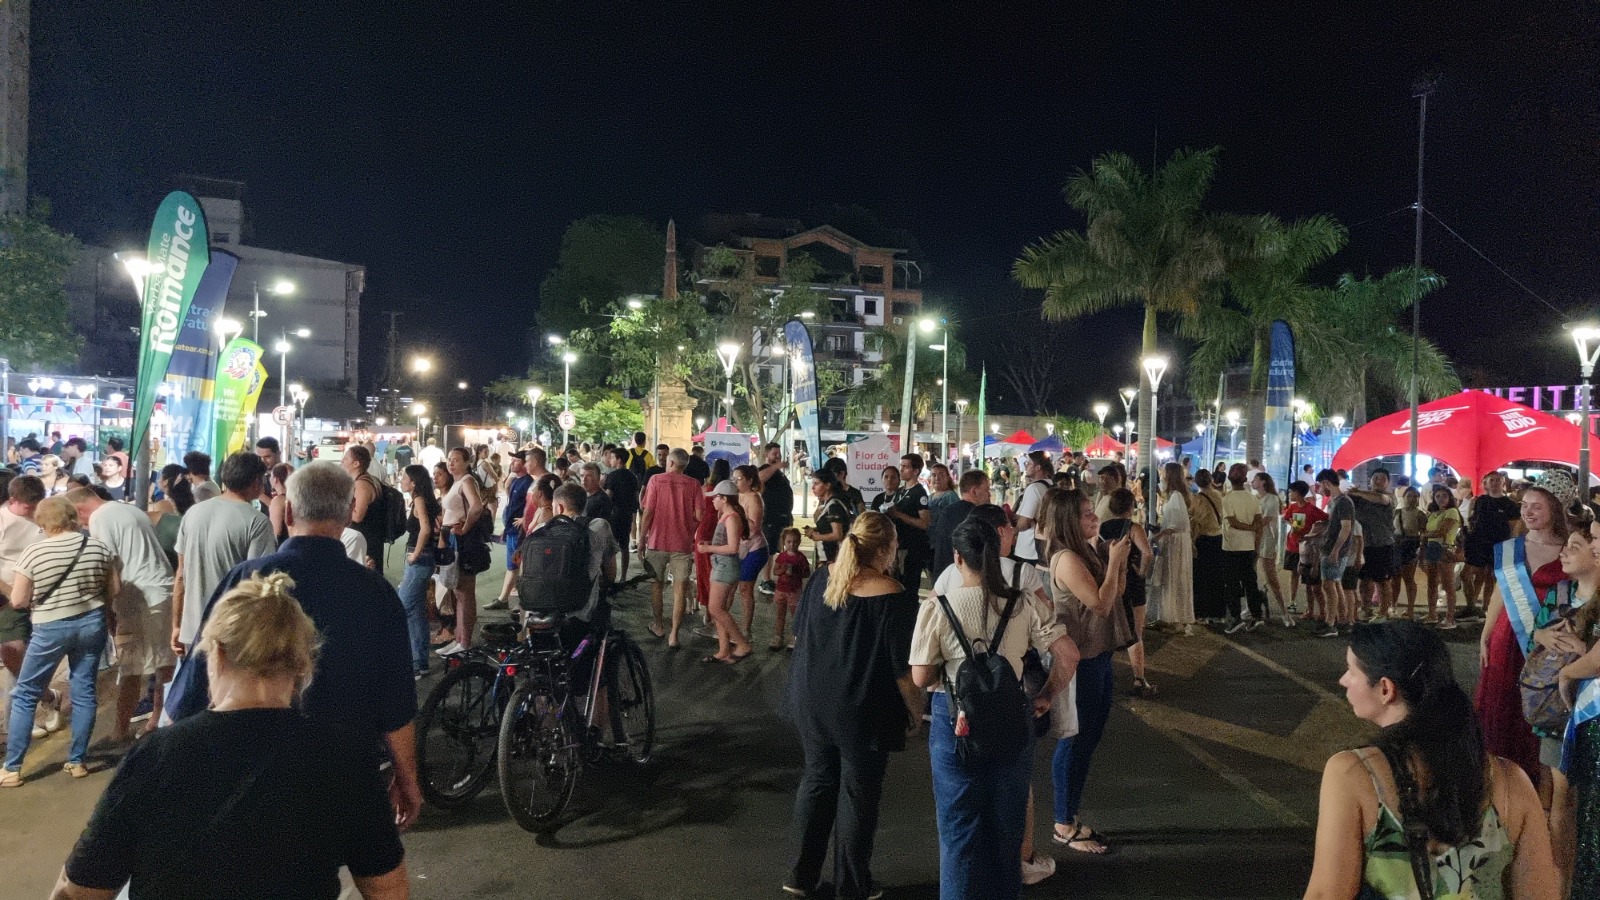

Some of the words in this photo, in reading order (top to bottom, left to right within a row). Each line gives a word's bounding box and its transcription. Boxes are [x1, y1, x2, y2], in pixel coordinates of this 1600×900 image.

[151, 205, 196, 354] Romance
[166, 432, 191, 450] TE
[855, 451, 875, 460] Flor
[877, 451, 889, 460] de
[855, 462, 889, 471] ciudad
